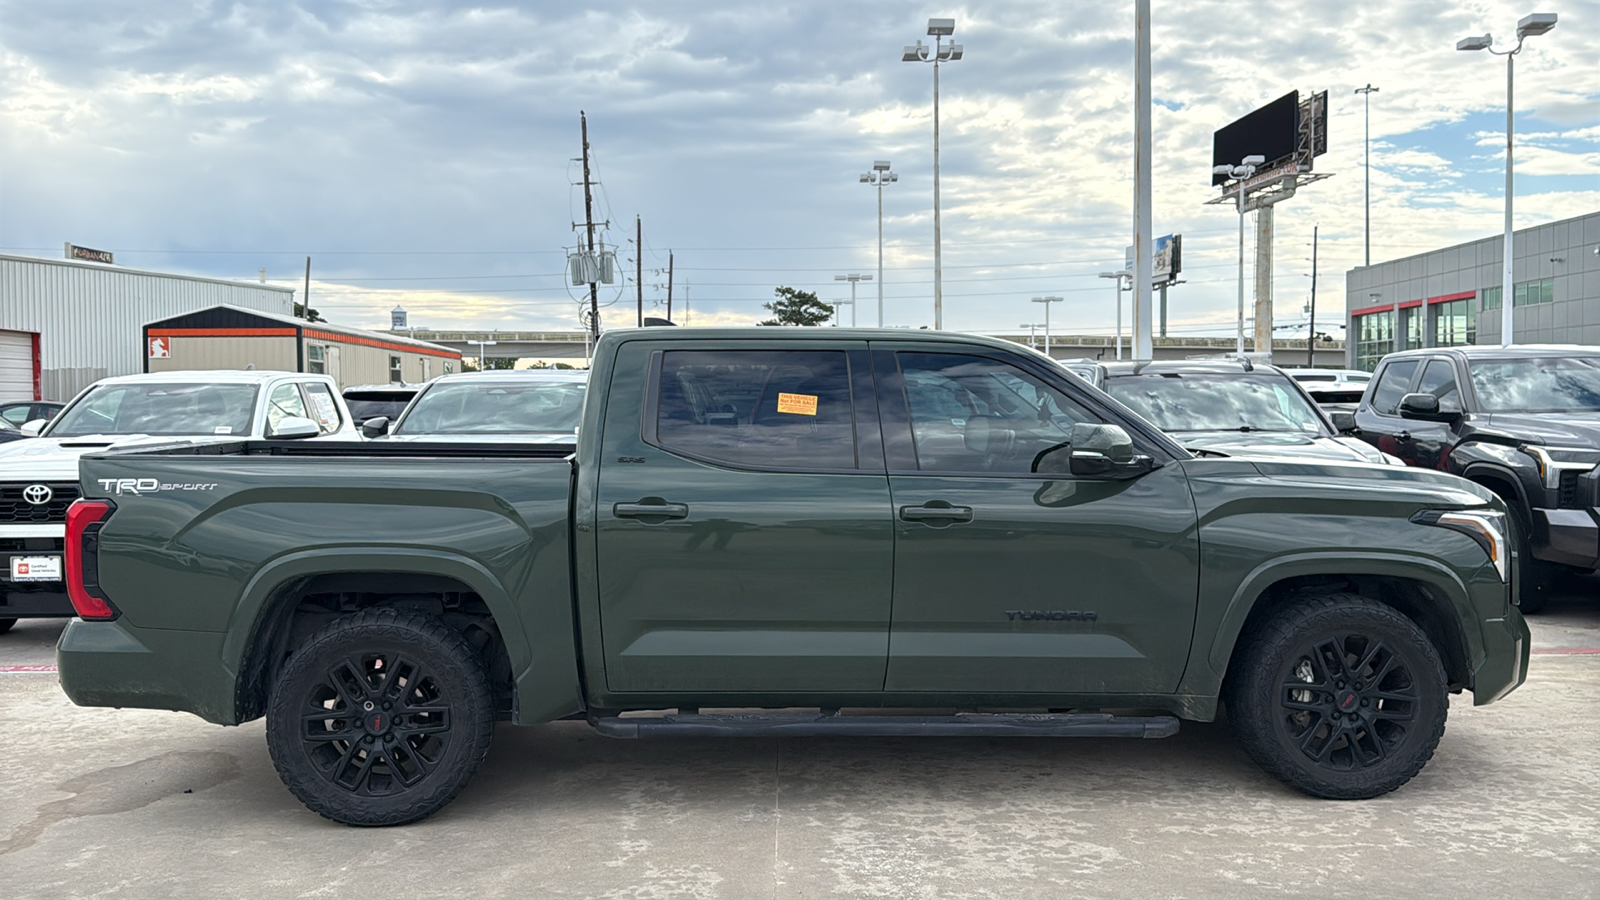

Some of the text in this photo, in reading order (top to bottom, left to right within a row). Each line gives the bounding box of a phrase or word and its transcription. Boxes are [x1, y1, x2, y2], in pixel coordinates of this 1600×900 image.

[97, 478, 218, 497] TRD SPORT
[1004, 610, 1098, 621] TUNDRA
